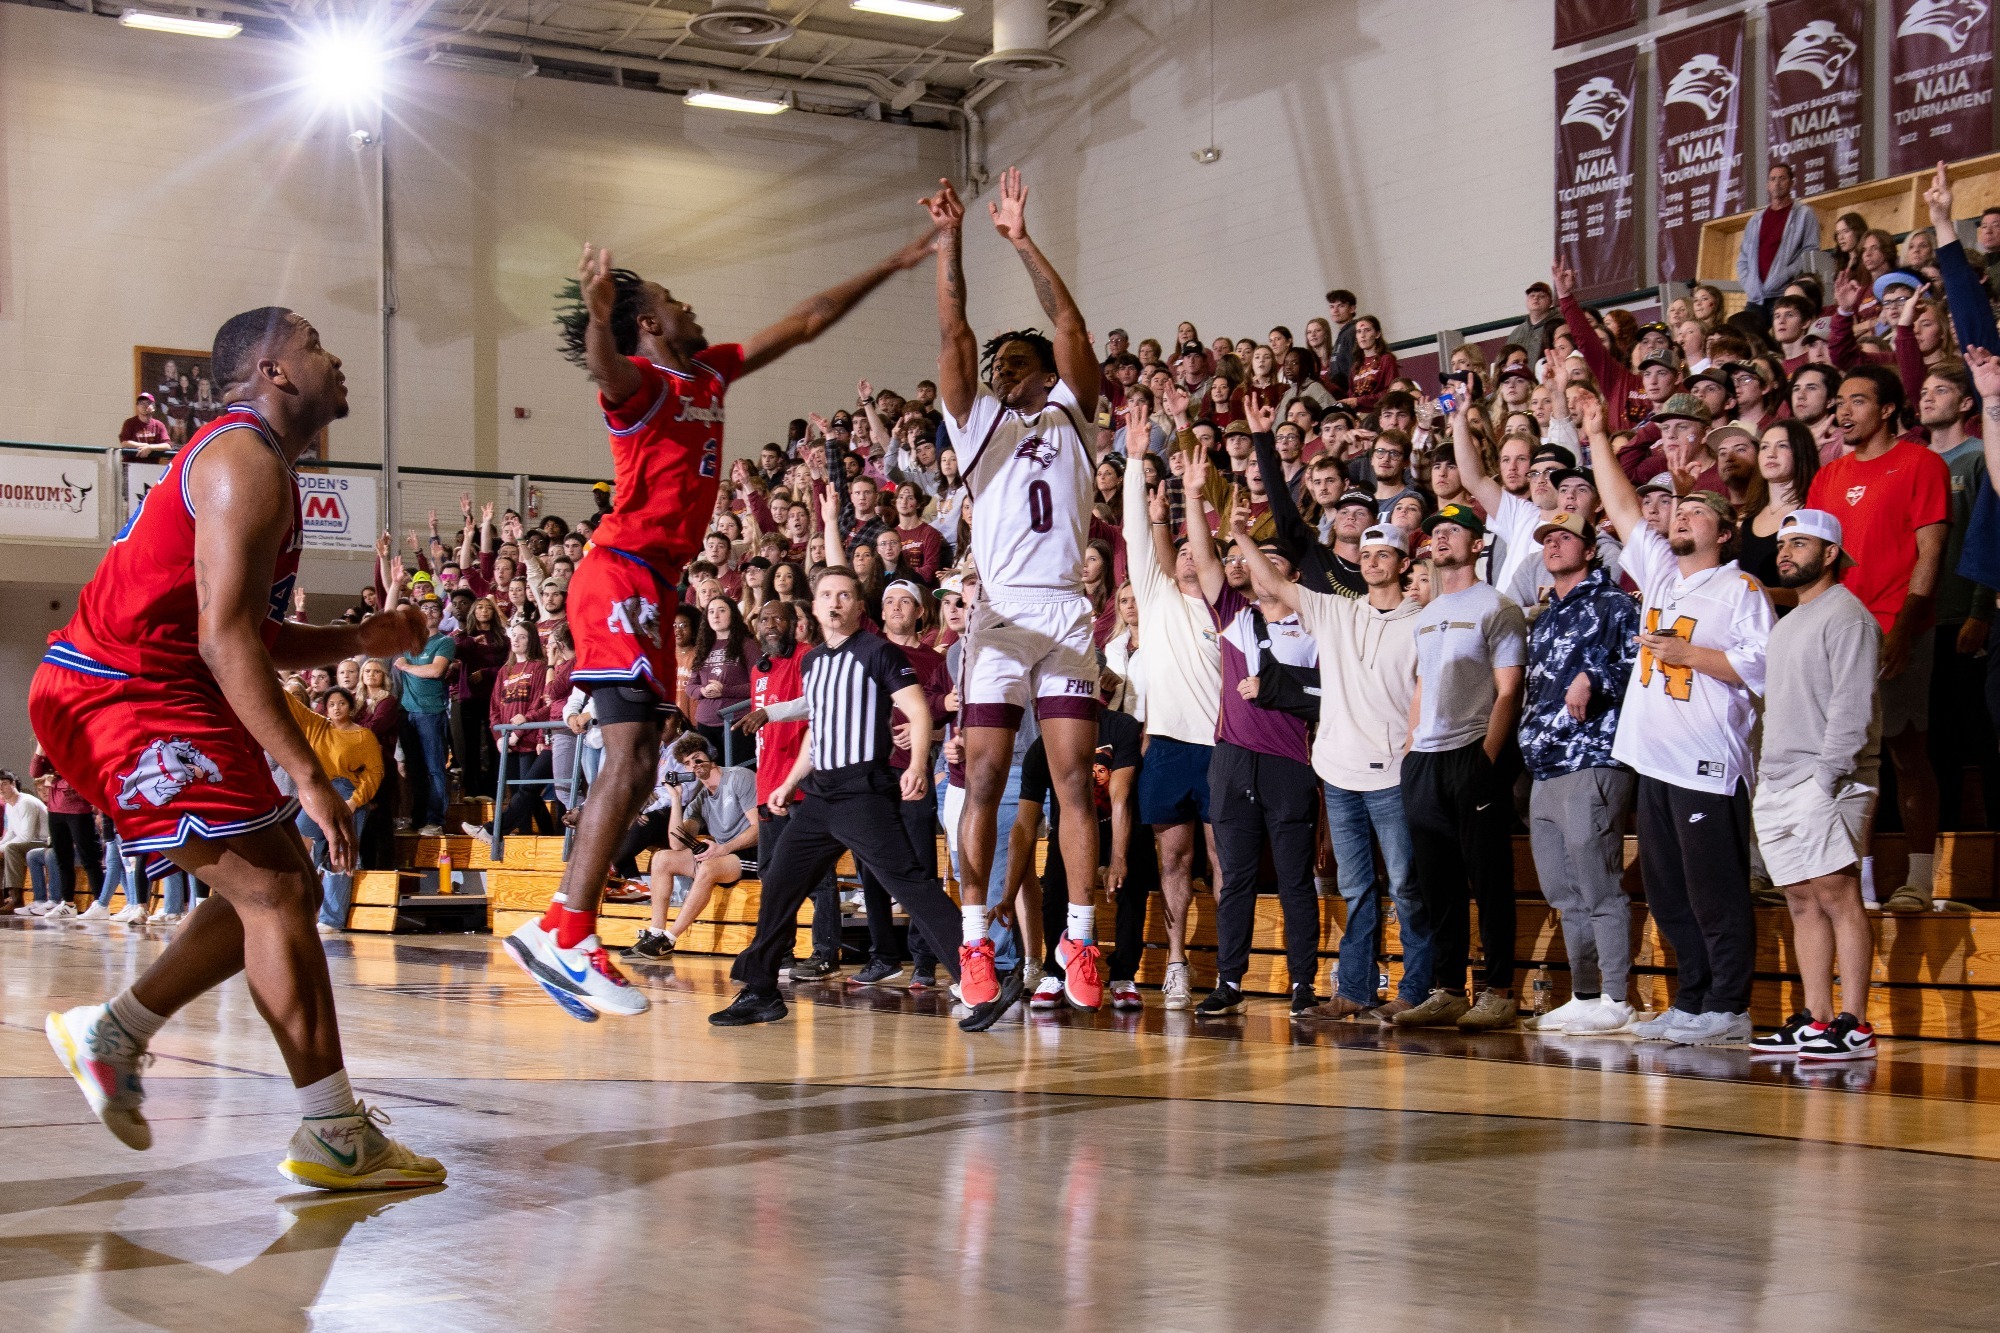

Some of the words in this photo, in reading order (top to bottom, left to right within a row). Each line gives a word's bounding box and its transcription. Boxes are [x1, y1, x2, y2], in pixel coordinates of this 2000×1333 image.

[1914, 70, 1970, 103] NAIA
[1790, 105, 1840, 137] NAIA
[1894, 88, 1993, 126] TOURNAMENT
[1578, 145, 1613, 161] BASEBALL
[1678, 135, 1724, 166] NAIA
[1769, 124, 1862, 157] TOURNAMENT
[1574, 155, 1618, 184] NAIA
[1661, 152, 1743, 186] TOURNAMENT
[1558, 172, 1635, 201] TOURNAMENT
[306, 497, 340, 519] M
[1029, 479, 1053, 534] 0
[303, 519, 343, 528] MARATHON
[1064, 679, 1094, 695] FHU
